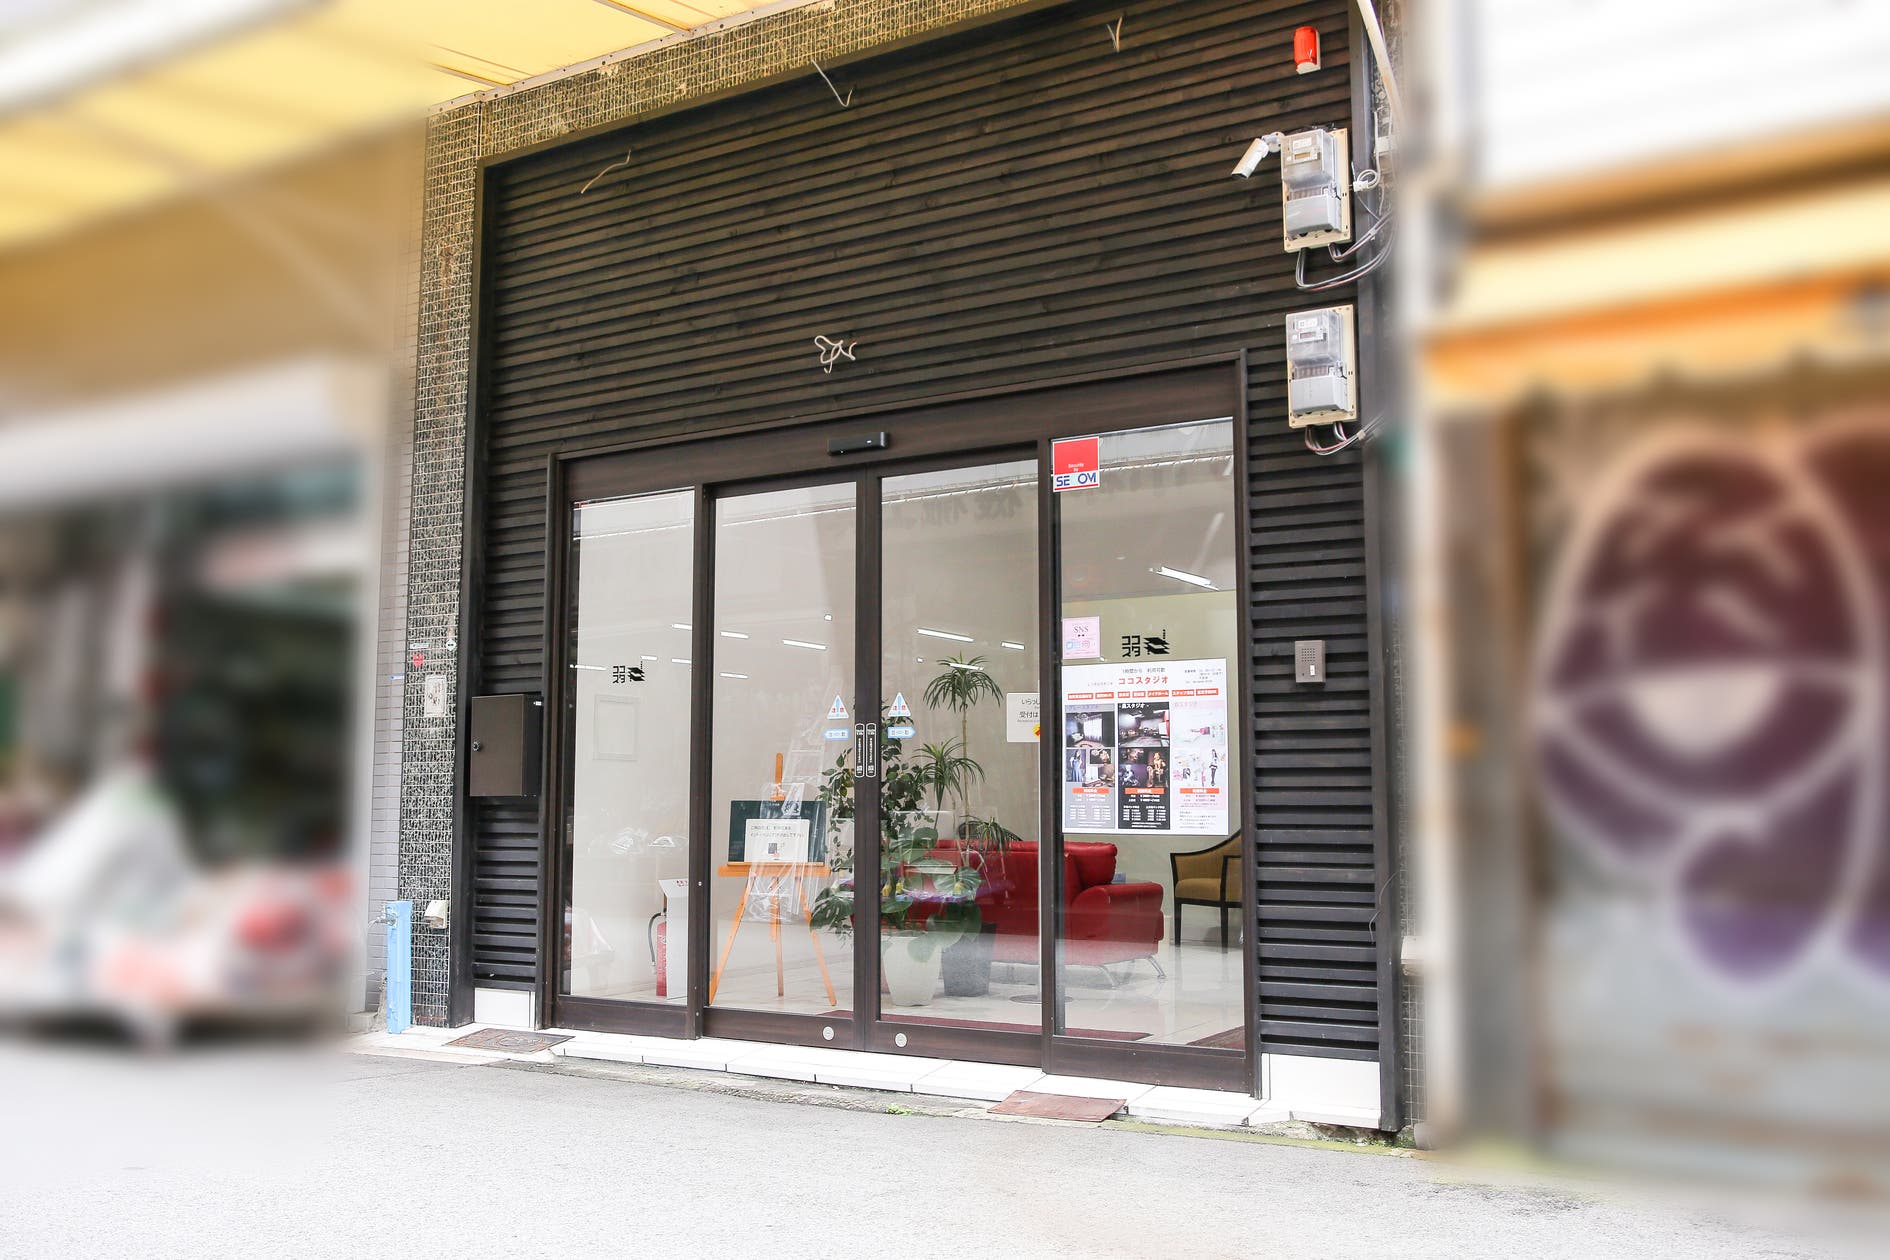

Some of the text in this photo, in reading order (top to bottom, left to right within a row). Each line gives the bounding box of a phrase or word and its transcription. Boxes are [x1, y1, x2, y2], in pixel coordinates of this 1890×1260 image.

[1056, 472, 1096, 487] SEOM
[1073, 625, 1089, 634] SNS
[1119, 675, 1169, 685] ココスタジオ
